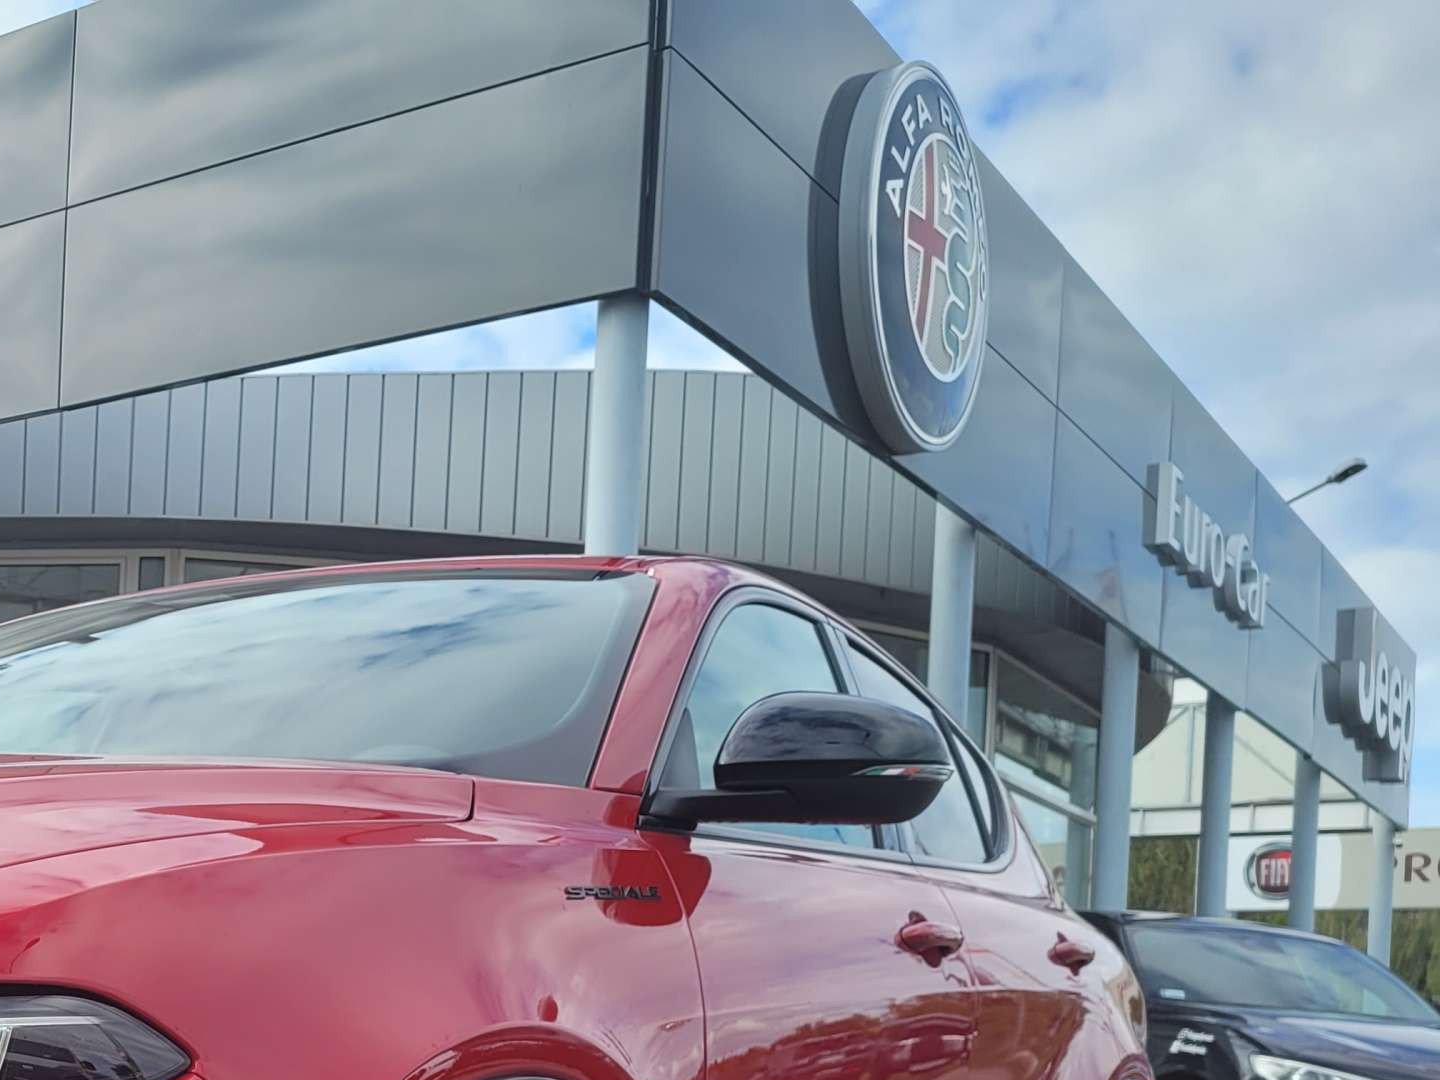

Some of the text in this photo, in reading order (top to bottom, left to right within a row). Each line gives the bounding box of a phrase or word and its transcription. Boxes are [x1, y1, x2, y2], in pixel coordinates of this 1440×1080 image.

[885, 94, 933, 218] ALFA
[1359, 606, 1414, 785] Jeep
[1260, 857, 1291, 887] FIA
